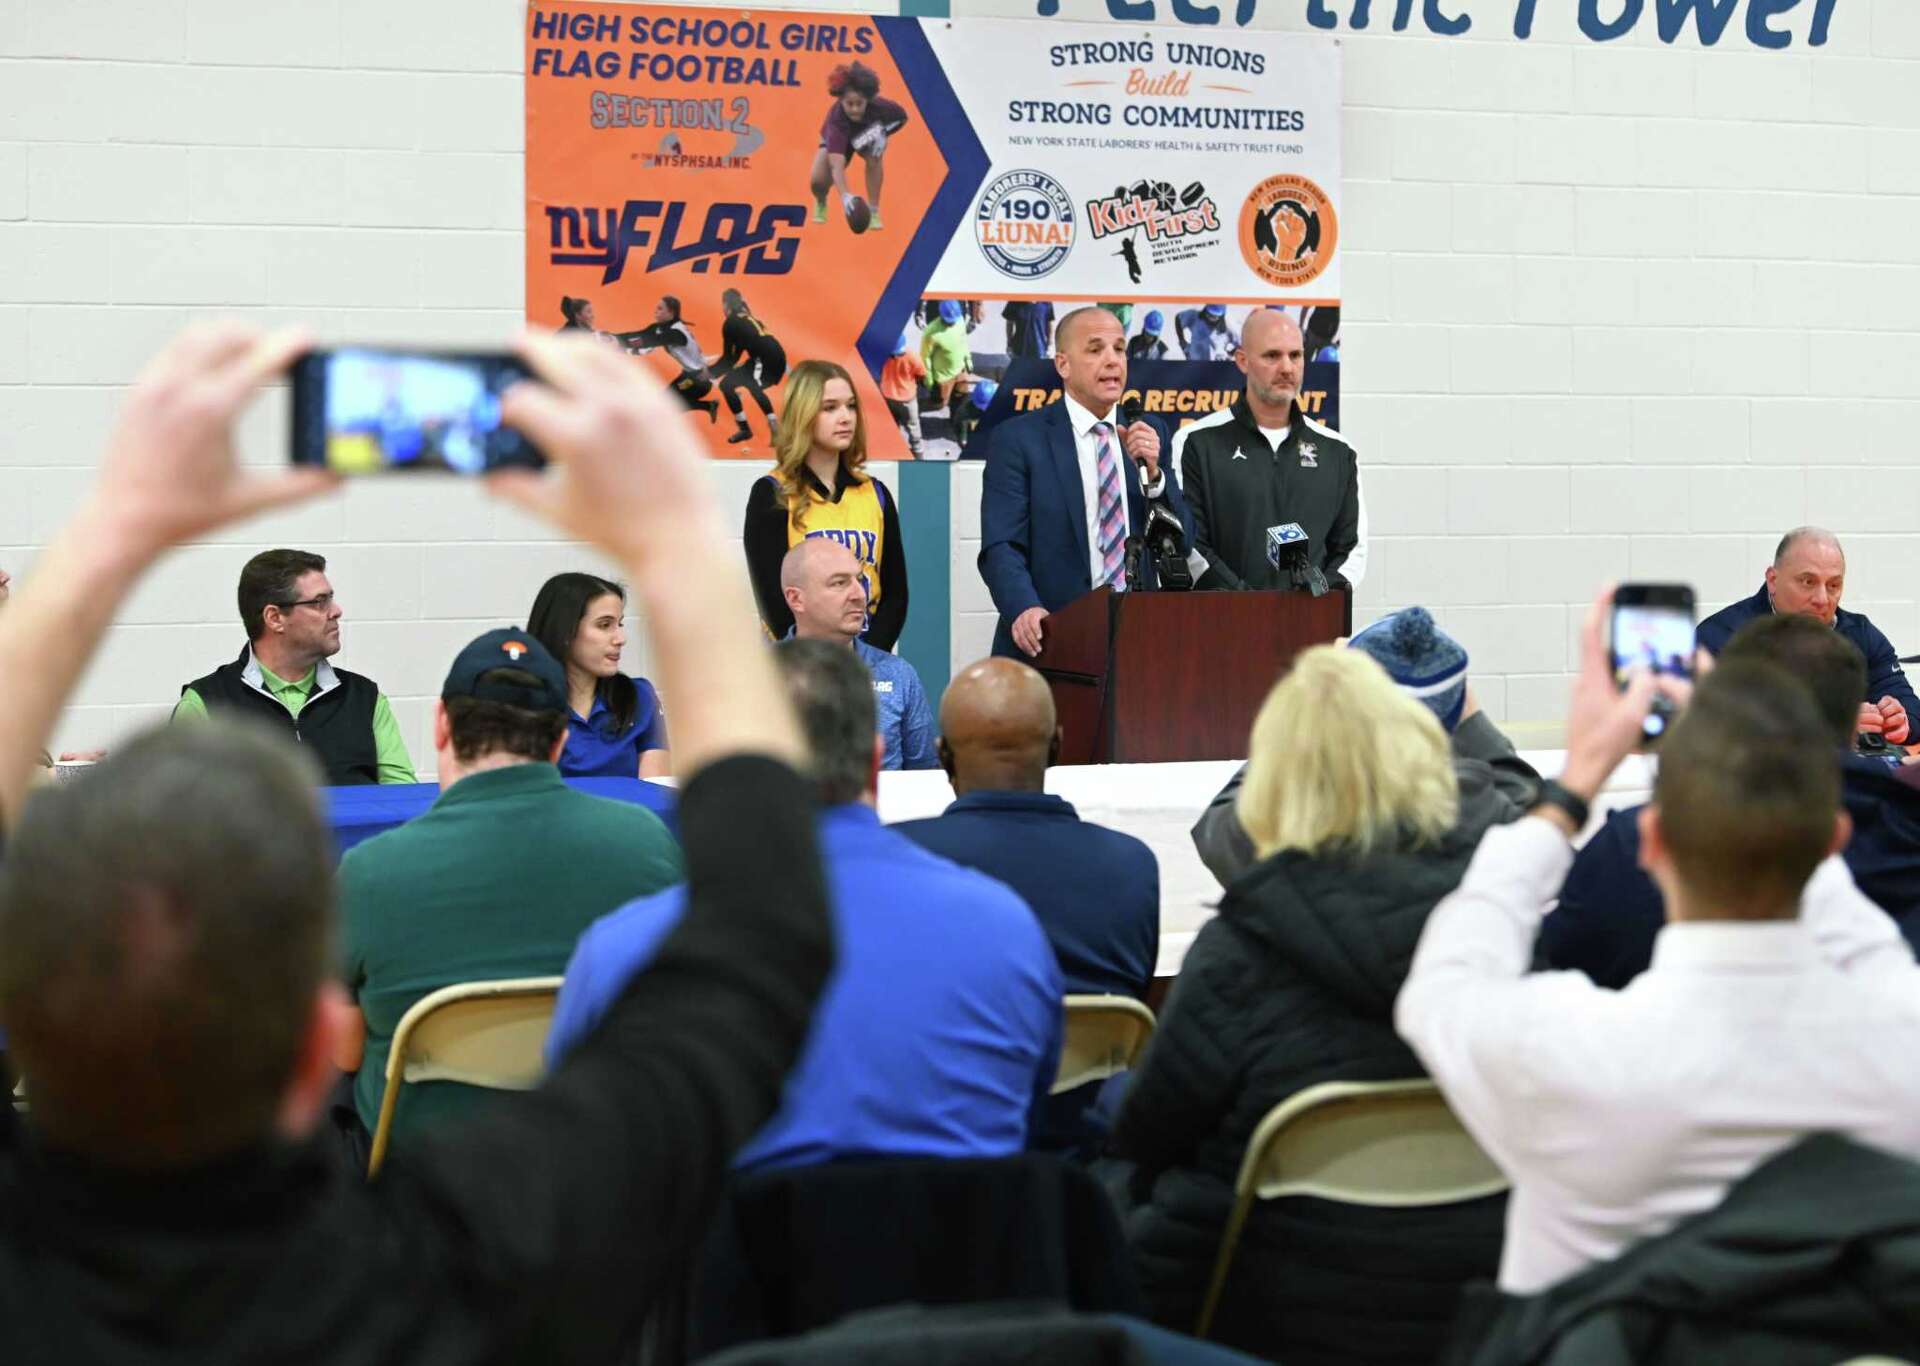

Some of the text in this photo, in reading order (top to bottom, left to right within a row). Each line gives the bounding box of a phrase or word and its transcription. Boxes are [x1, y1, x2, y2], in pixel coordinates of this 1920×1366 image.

[532, 11, 874, 54] HIGH SCHOOL GIRLS
[532, 48, 801, 87] FLAG FOOTBALL
[1050, 41, 1265, 75] STRONG UNIONS
[1125, 68, 1191, 97] Build
[591, 90, 750, 135] SECTION 2
[1009, 100, 1304, 131] STRONG COMMUNITIES
[1009, 136, 1033, 146] NEW
[1036, 136, 1063, 147] YORK
[1066, 137, 1096, 148] STATE
[1155, 140, 1193, 151] HEALTH
[1195, 141, 1202, 151] &
[1205, 142, 1240, 153] SAFETY
[1243, 143, 1273, 154] TRUST
[1276, 144, 1303, 155] FUND
[1001, 200, 1050, 220] 190
[1087, 194, 1159, 239] Kidz
[1268, 259, 1307, 272] RISING
